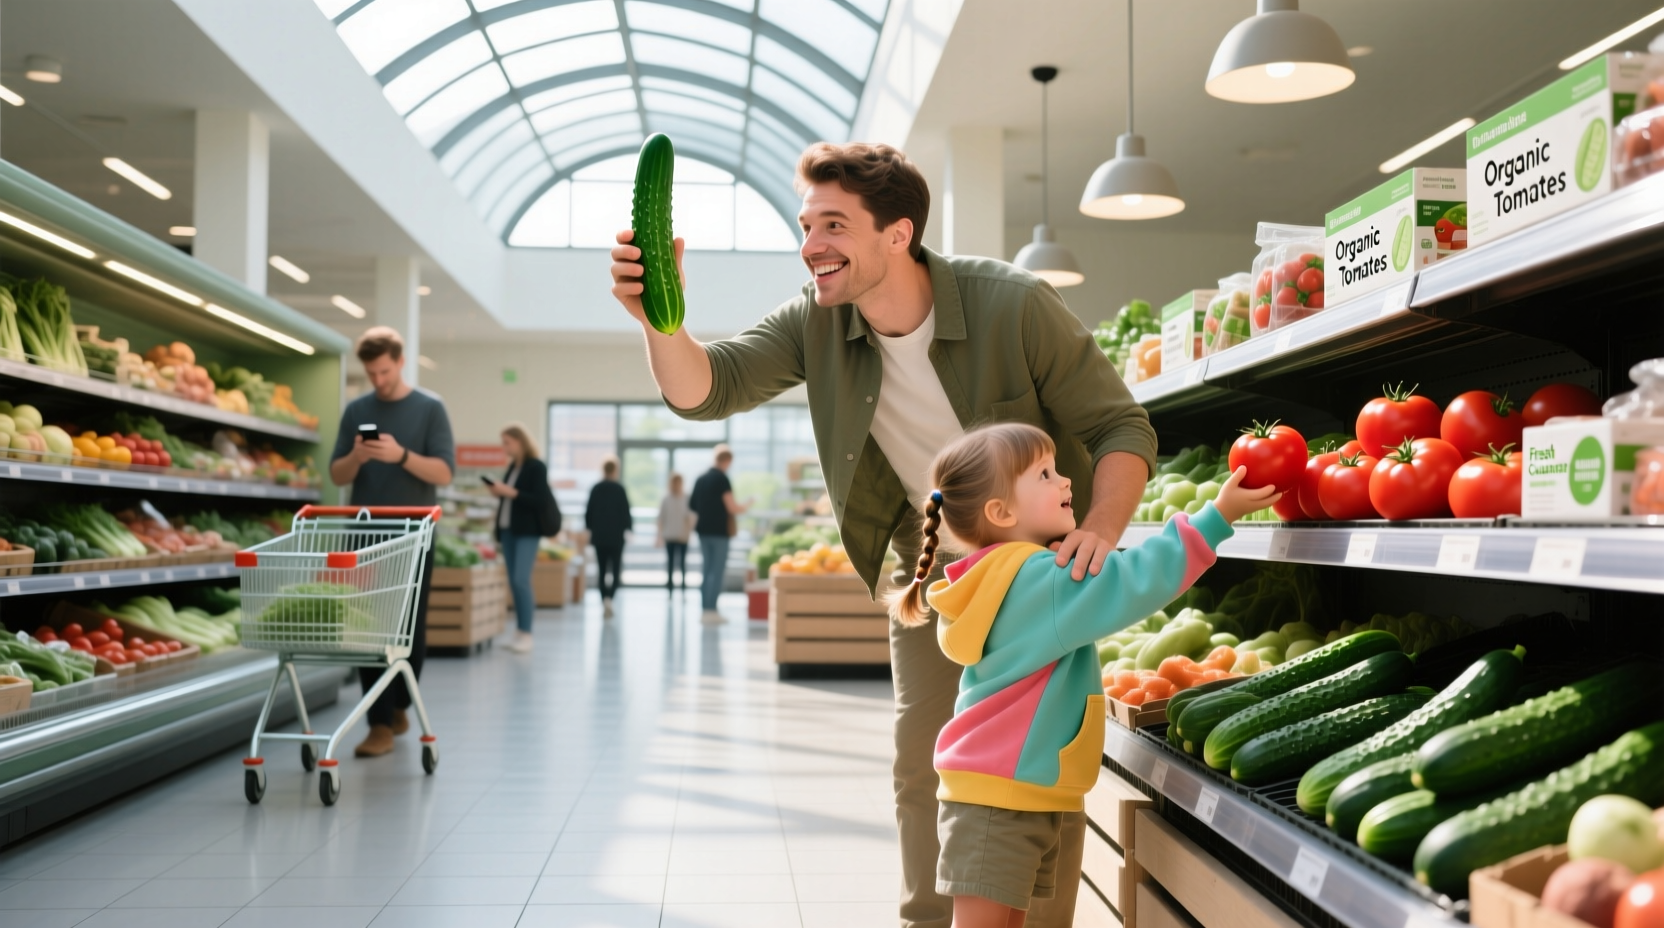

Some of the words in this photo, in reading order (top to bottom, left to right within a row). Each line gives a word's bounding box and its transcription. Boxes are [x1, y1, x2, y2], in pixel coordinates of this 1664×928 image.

[1484, 138, 1550, 186] Organic
[1494, 171, 1566, 217] Tomates
[1335, 226, 1380, 262] Organic
